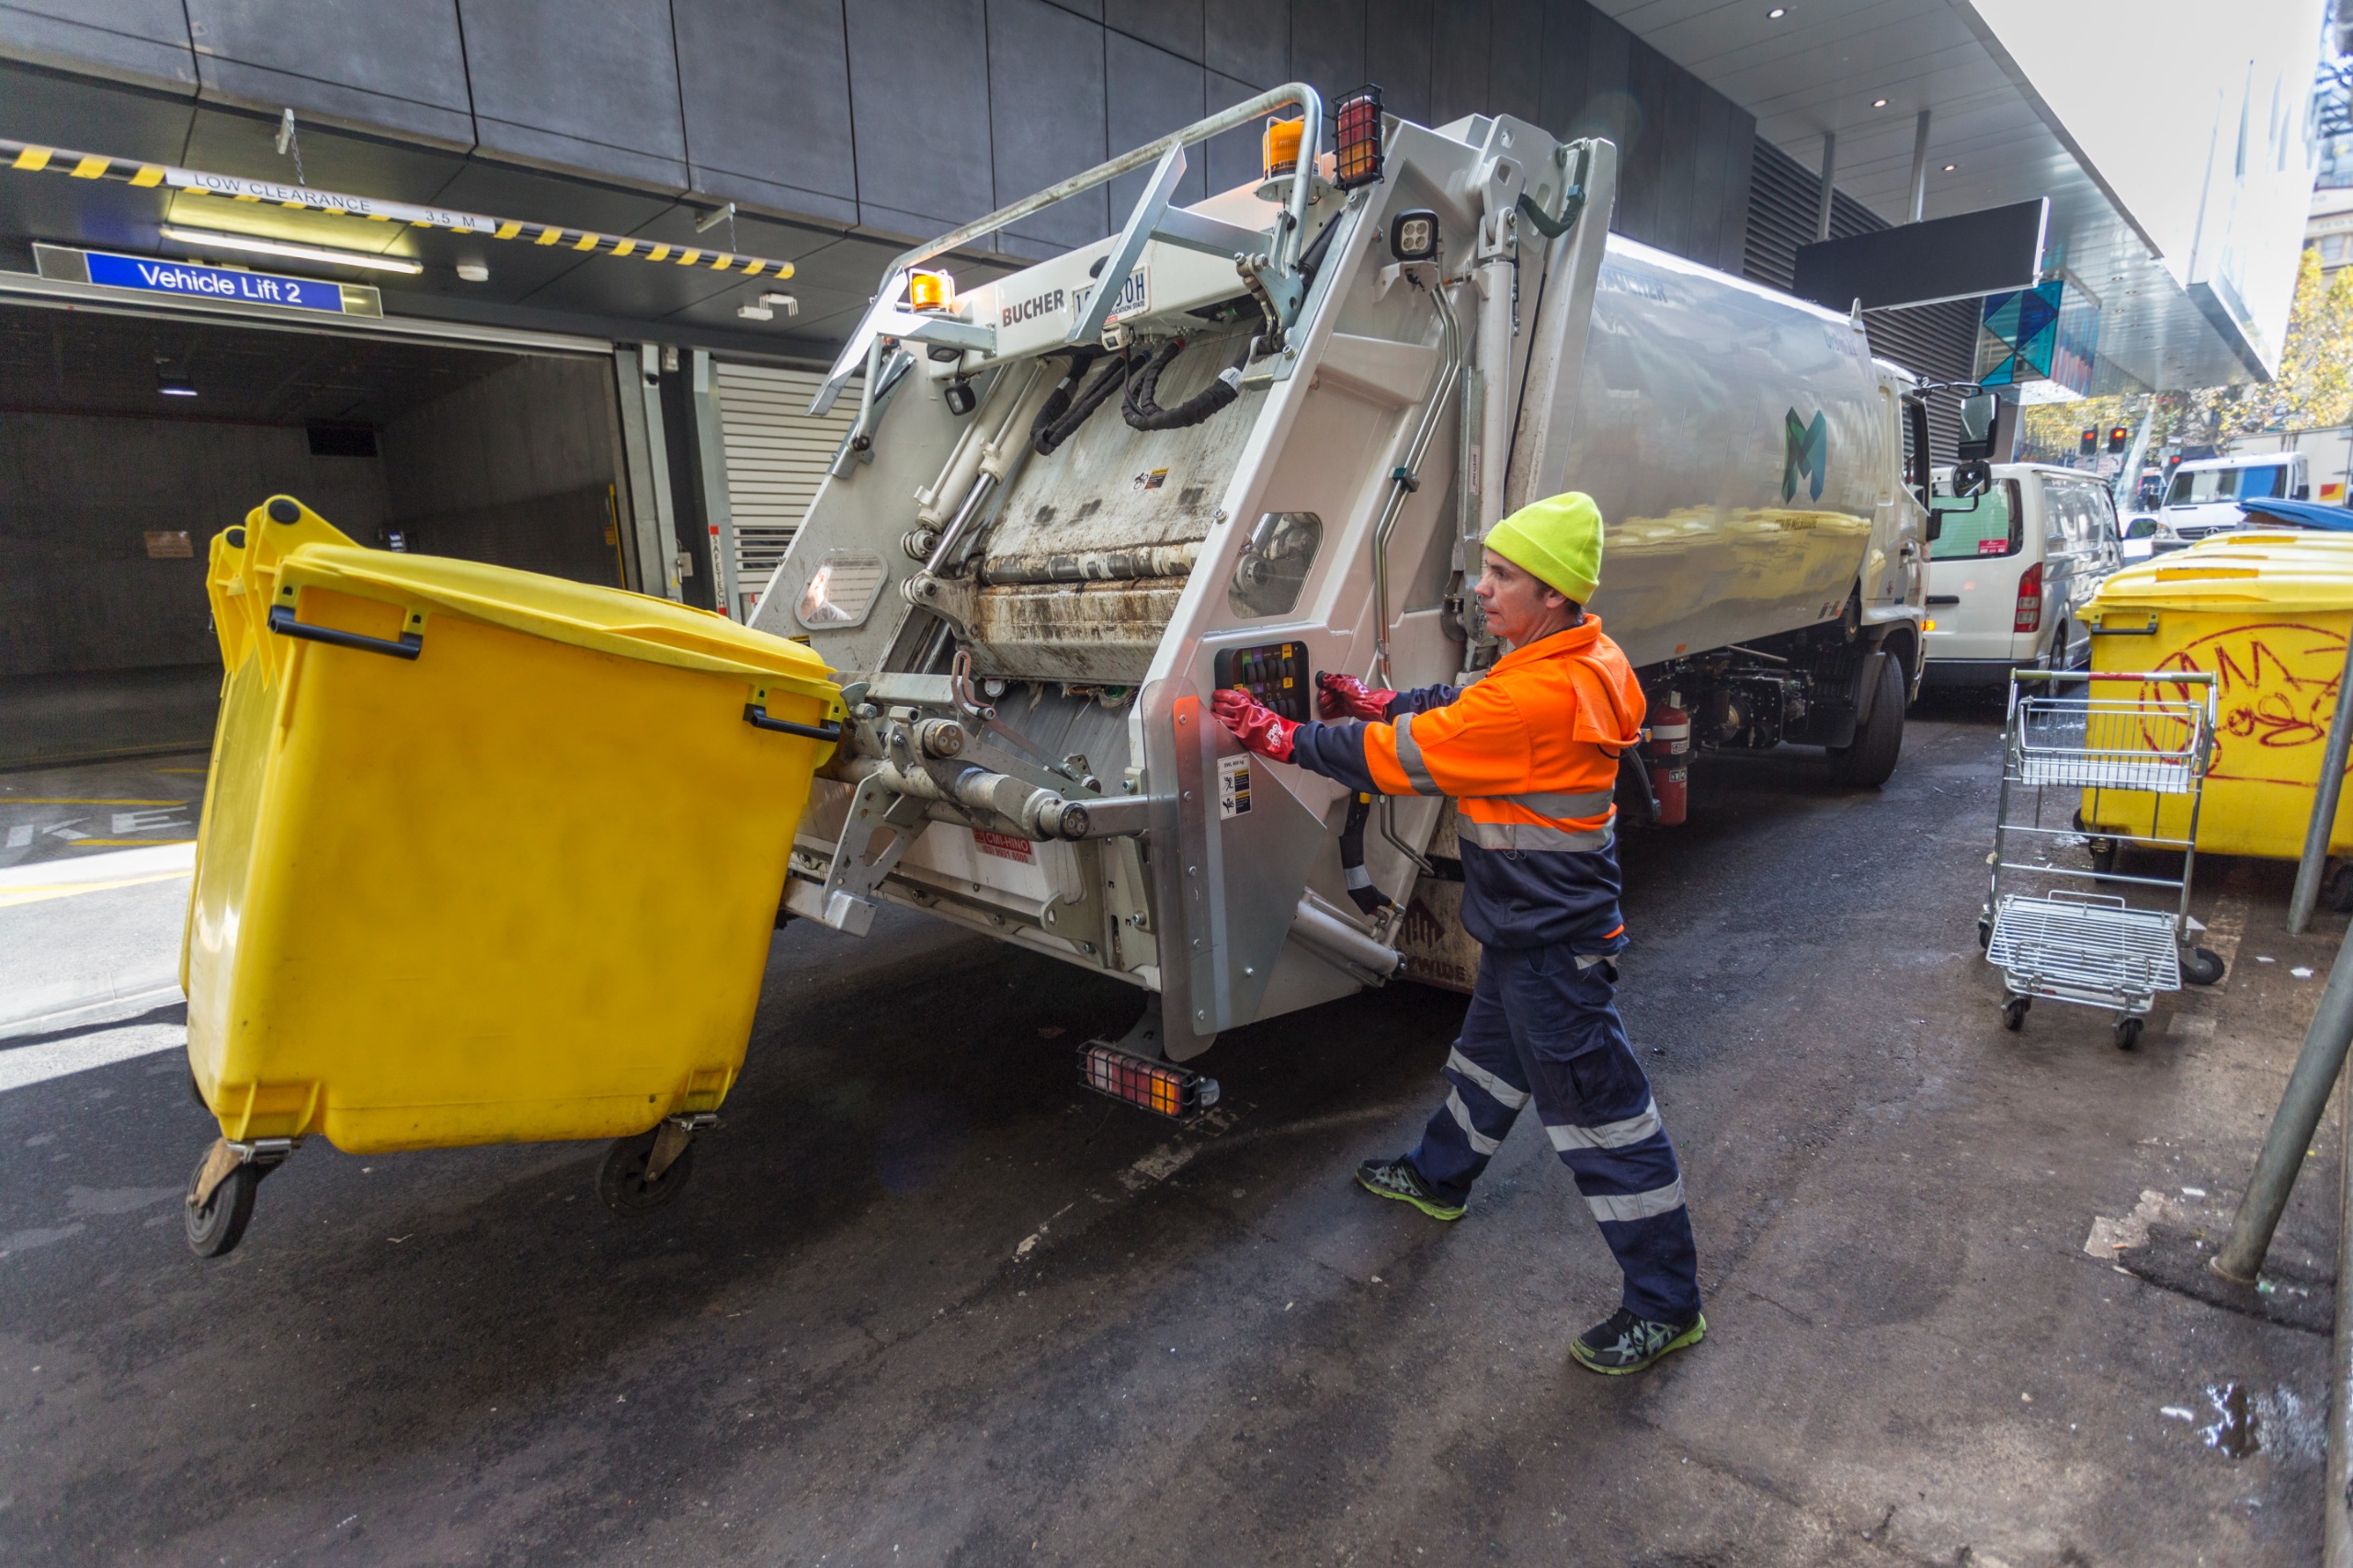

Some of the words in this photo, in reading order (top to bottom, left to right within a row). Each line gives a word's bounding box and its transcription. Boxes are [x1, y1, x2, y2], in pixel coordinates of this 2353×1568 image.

[194, 174, 241, 192] LOW
[249, 183, 372, 212] CLEARANCE
[426, 210, 451, 224] 3.5
[462, 215, 476, 228] M
[137, 263, 236, 295] Vehicle
[242, 277, 281, 301] Lift
[286, 282, 302, 303] 2
[1001, 289, 1065, 328] BUCHER
[1108, 304, 1132, 316] DUCATION
[1132, 300, 1145, 310] STATE
[712, 536, 725, 607] SAFETECH
[985, 832, 1029, 852] CMI-HINO
[995, 847, 1011, 858] 9931
[1407, 956, 1467, 983] YWIDE
